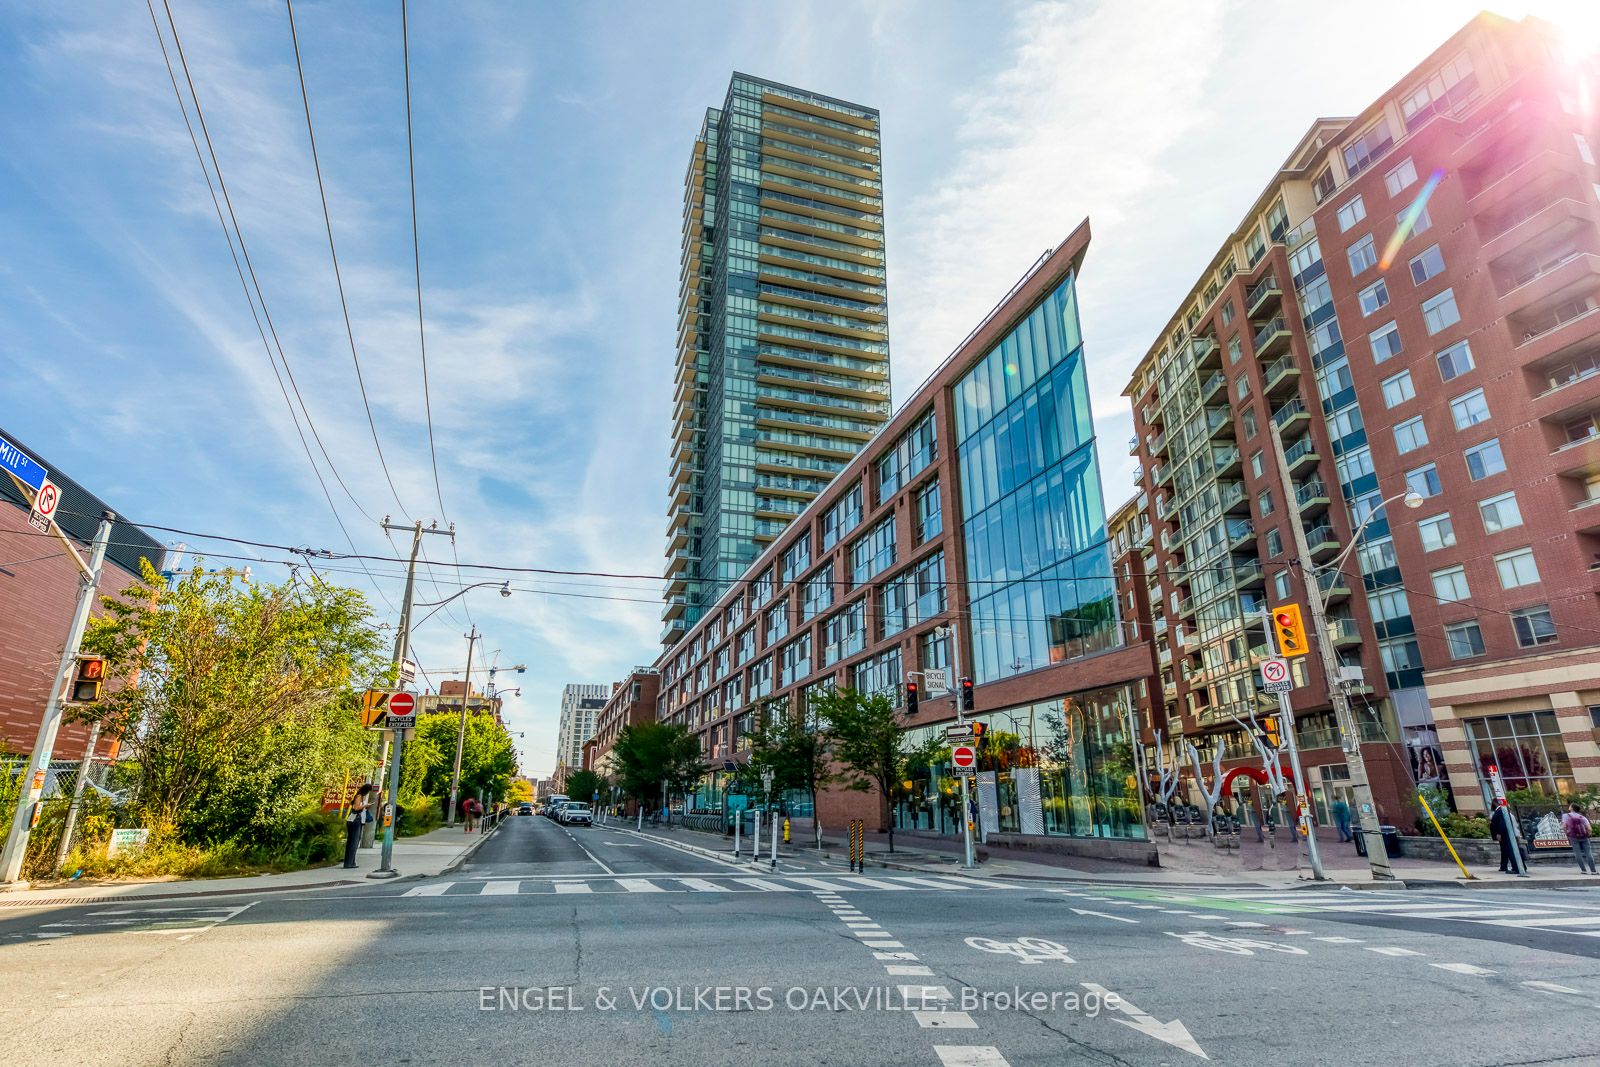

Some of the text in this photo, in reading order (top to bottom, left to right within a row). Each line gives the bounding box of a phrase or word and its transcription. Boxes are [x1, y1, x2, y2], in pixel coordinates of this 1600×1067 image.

[0, 442, 28, 469] Mill St
[926, 672, 945, 680] BICYCLE
[927, 681, 945, 689] SIGNAL
